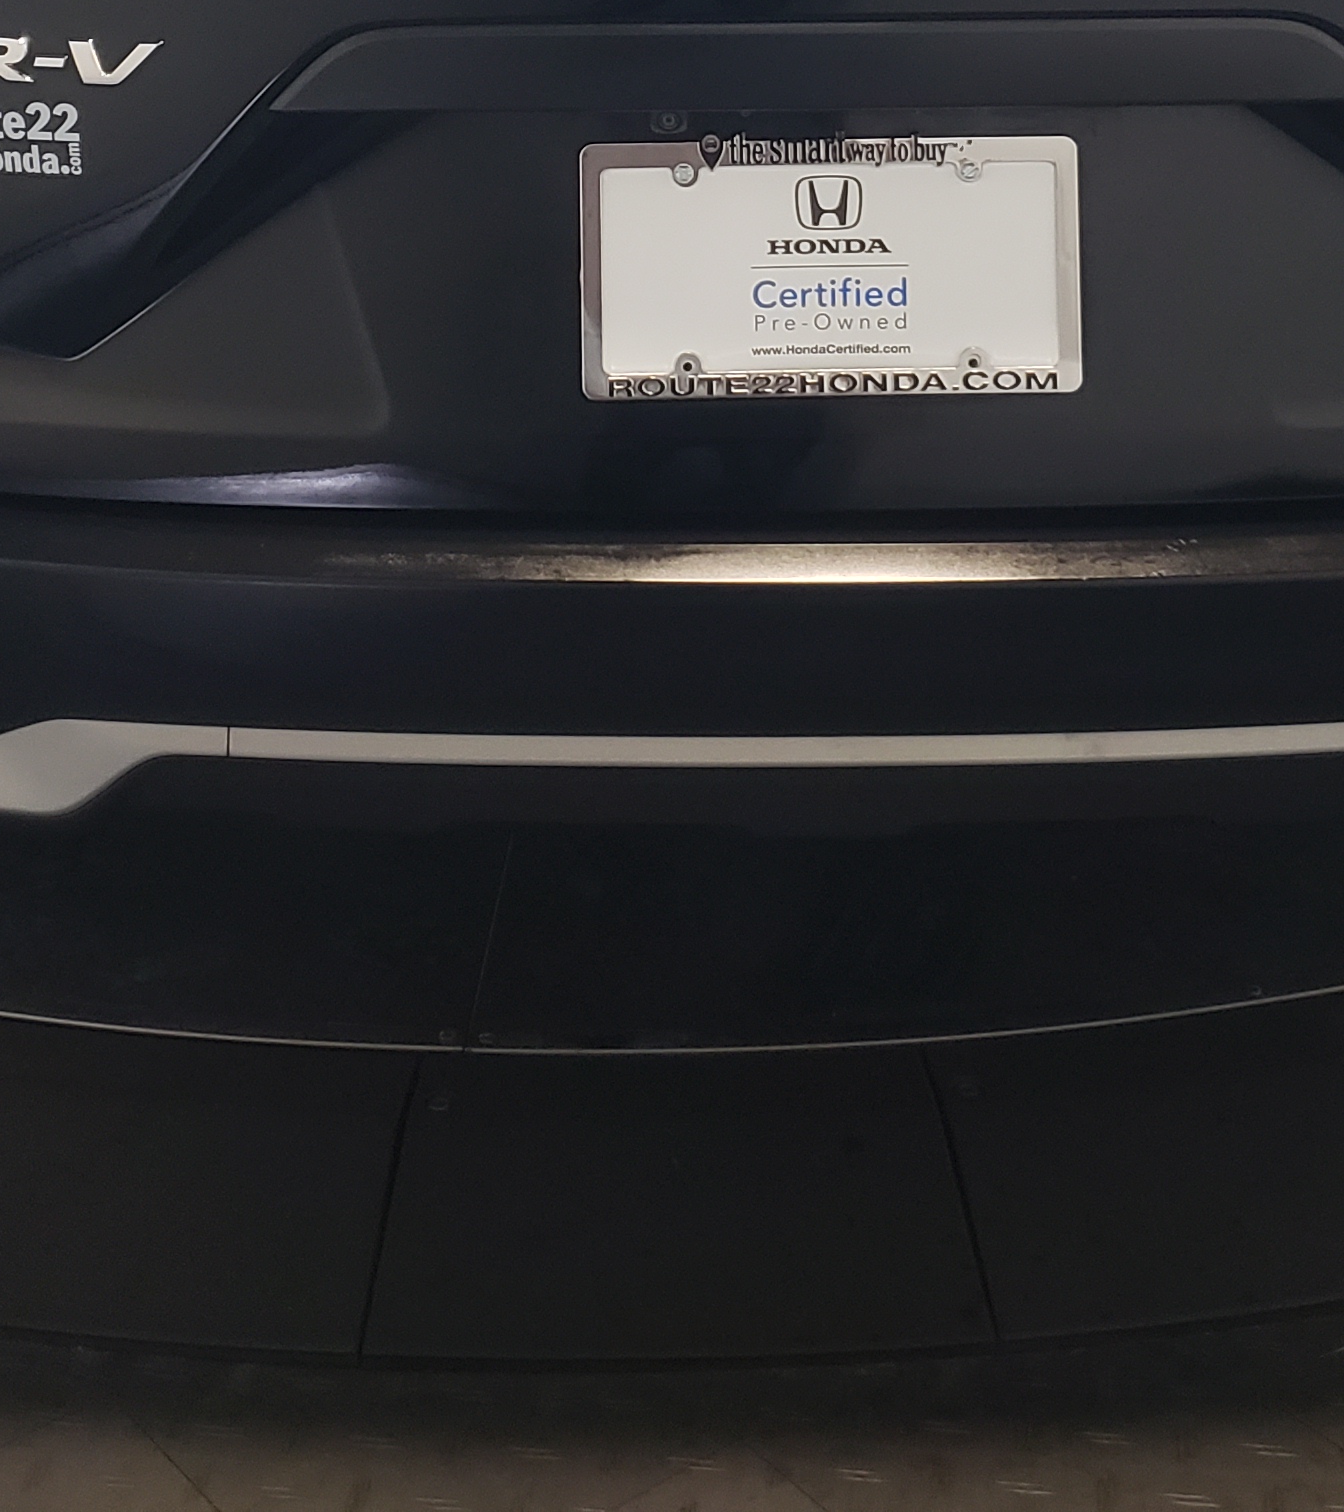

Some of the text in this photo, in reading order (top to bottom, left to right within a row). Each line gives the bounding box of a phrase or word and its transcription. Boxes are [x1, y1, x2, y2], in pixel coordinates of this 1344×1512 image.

[729, 133, 765, 164] the
[847, 142, 887, 167] way
[890, 137, 909, 163] to
[914, 135, 949, 167] buy
[766, 238, 892, 255] HONDA
[752, 276, 908, 309] Certified
[754, 311, 908, 332] Pre-Owned
[751, 343, 911, 356] www.HondaCertified.com
[608, 370, 1058, 398] ROUTE22HONDA.COM
